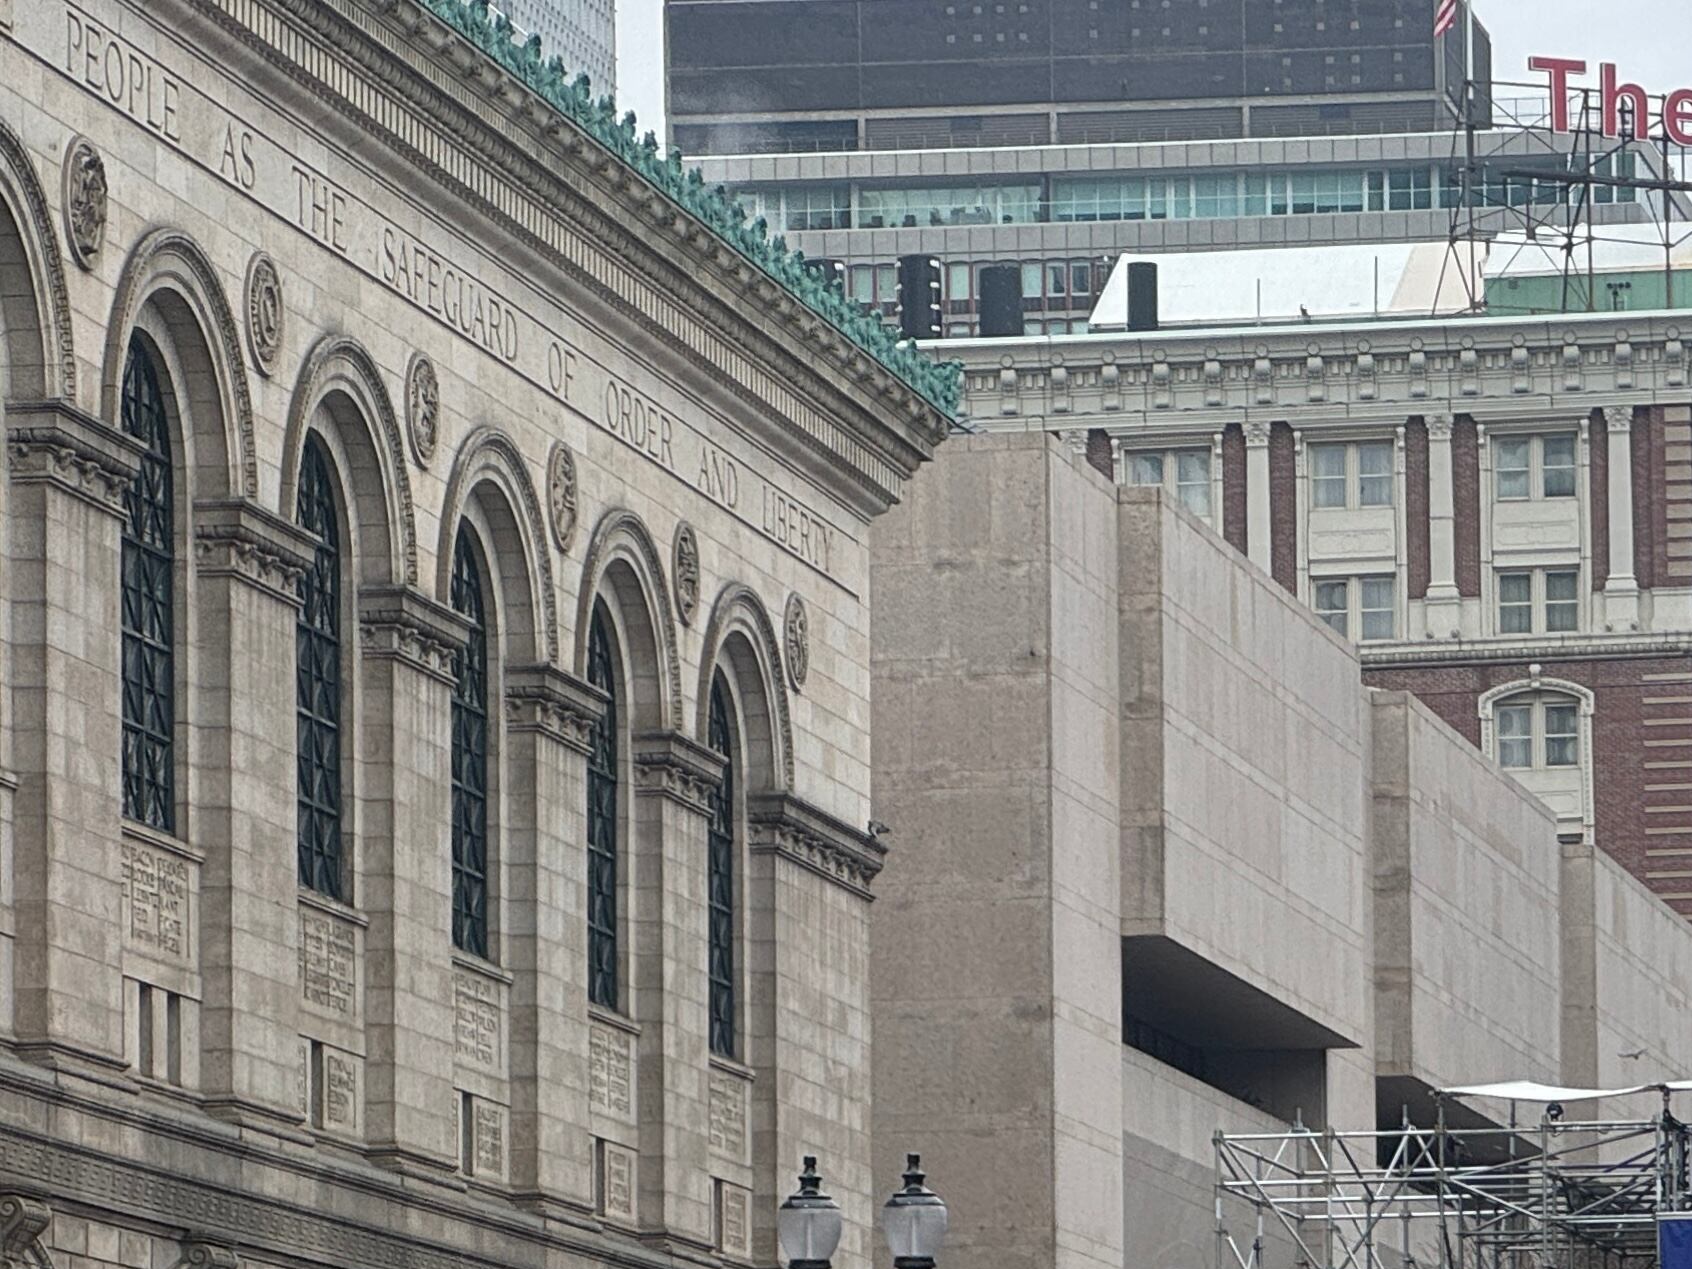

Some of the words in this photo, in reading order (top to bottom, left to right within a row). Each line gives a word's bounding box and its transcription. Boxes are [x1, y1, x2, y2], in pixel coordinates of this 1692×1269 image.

[66, 10, 181, 144] PEOPLE
[220, 120, 256, 190] AS
[291, 165, 348, 253] THE
[383, 228, 518, 363] SAFEGUARD
[548, 341, 578, 400] OF
[606, 380, 675, 470] ORDER
[698, 446, 738, 509] AND
[762, 485, 834, 573] LIBERTY
